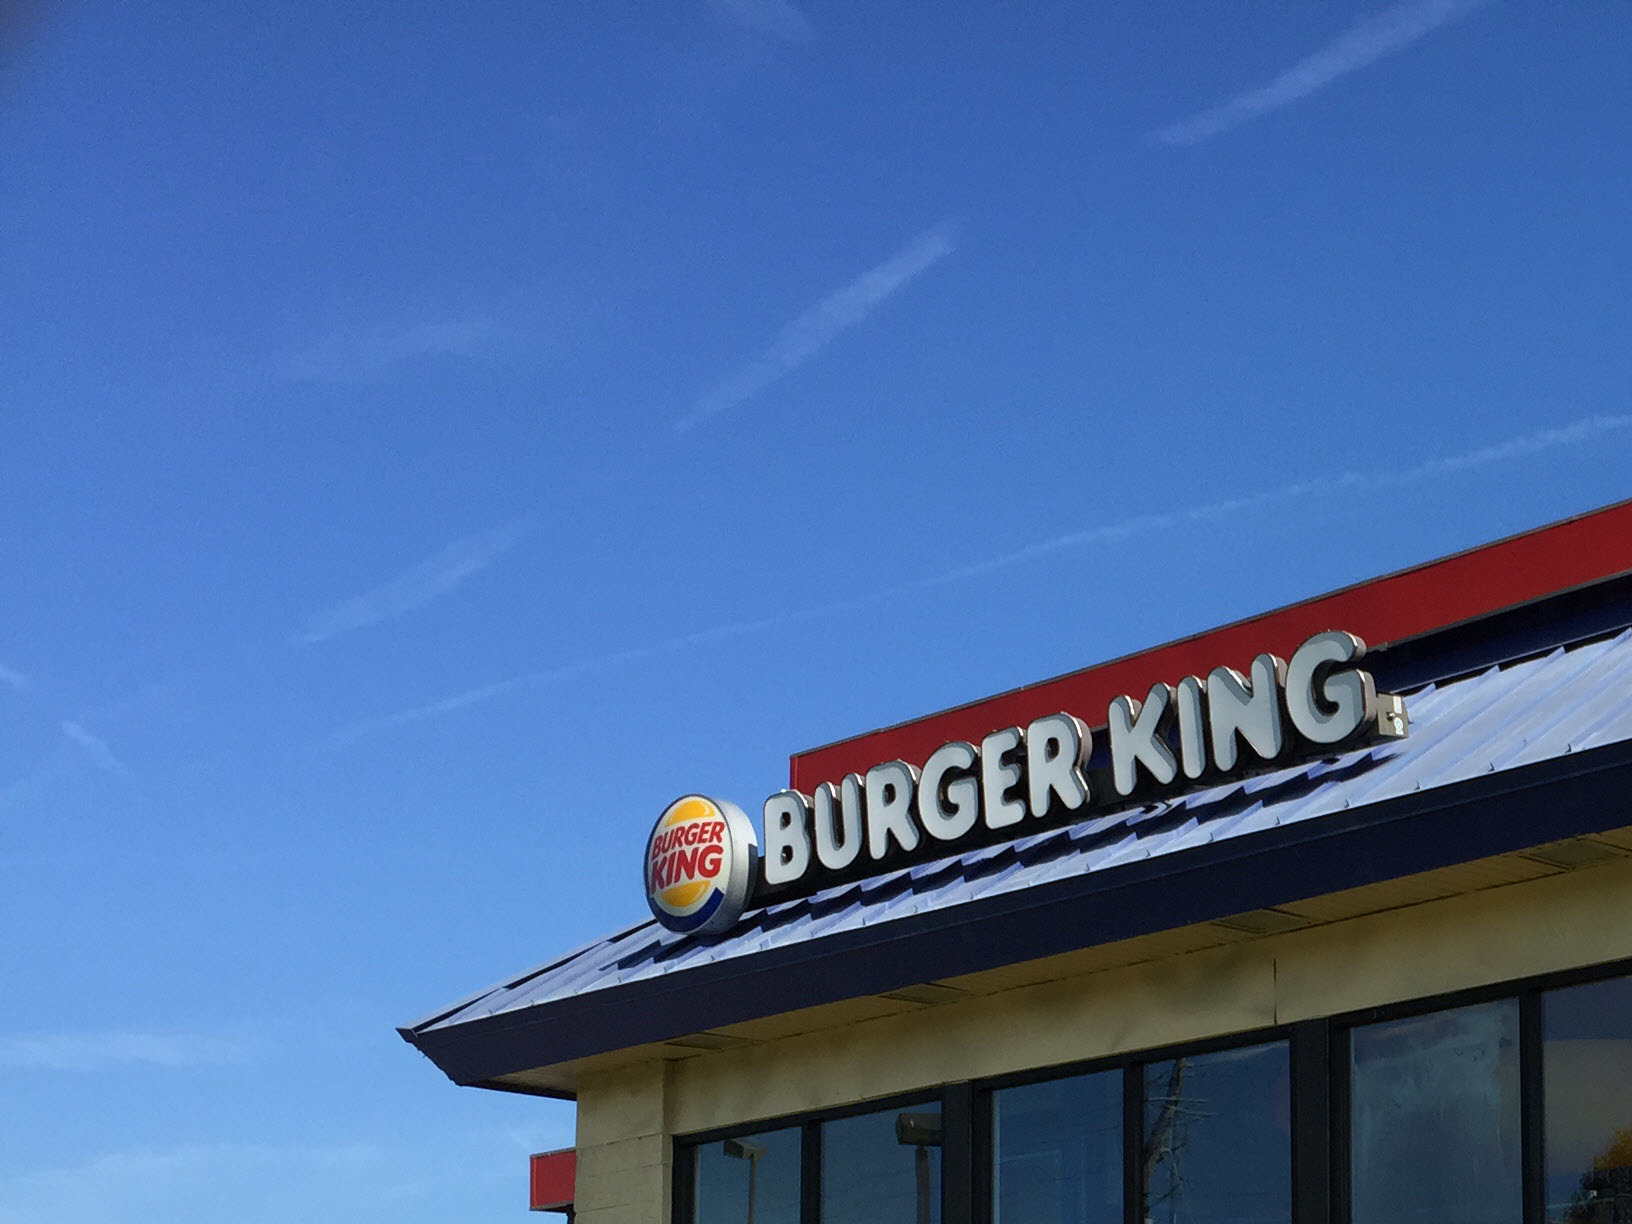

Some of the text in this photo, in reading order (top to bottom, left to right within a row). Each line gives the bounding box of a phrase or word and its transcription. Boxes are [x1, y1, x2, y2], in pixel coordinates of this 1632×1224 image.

[764, 629, 1377, 886] BURGER KING
[651, 821, 726, 861] BURGER
[650, 844, 725, 895] KING
